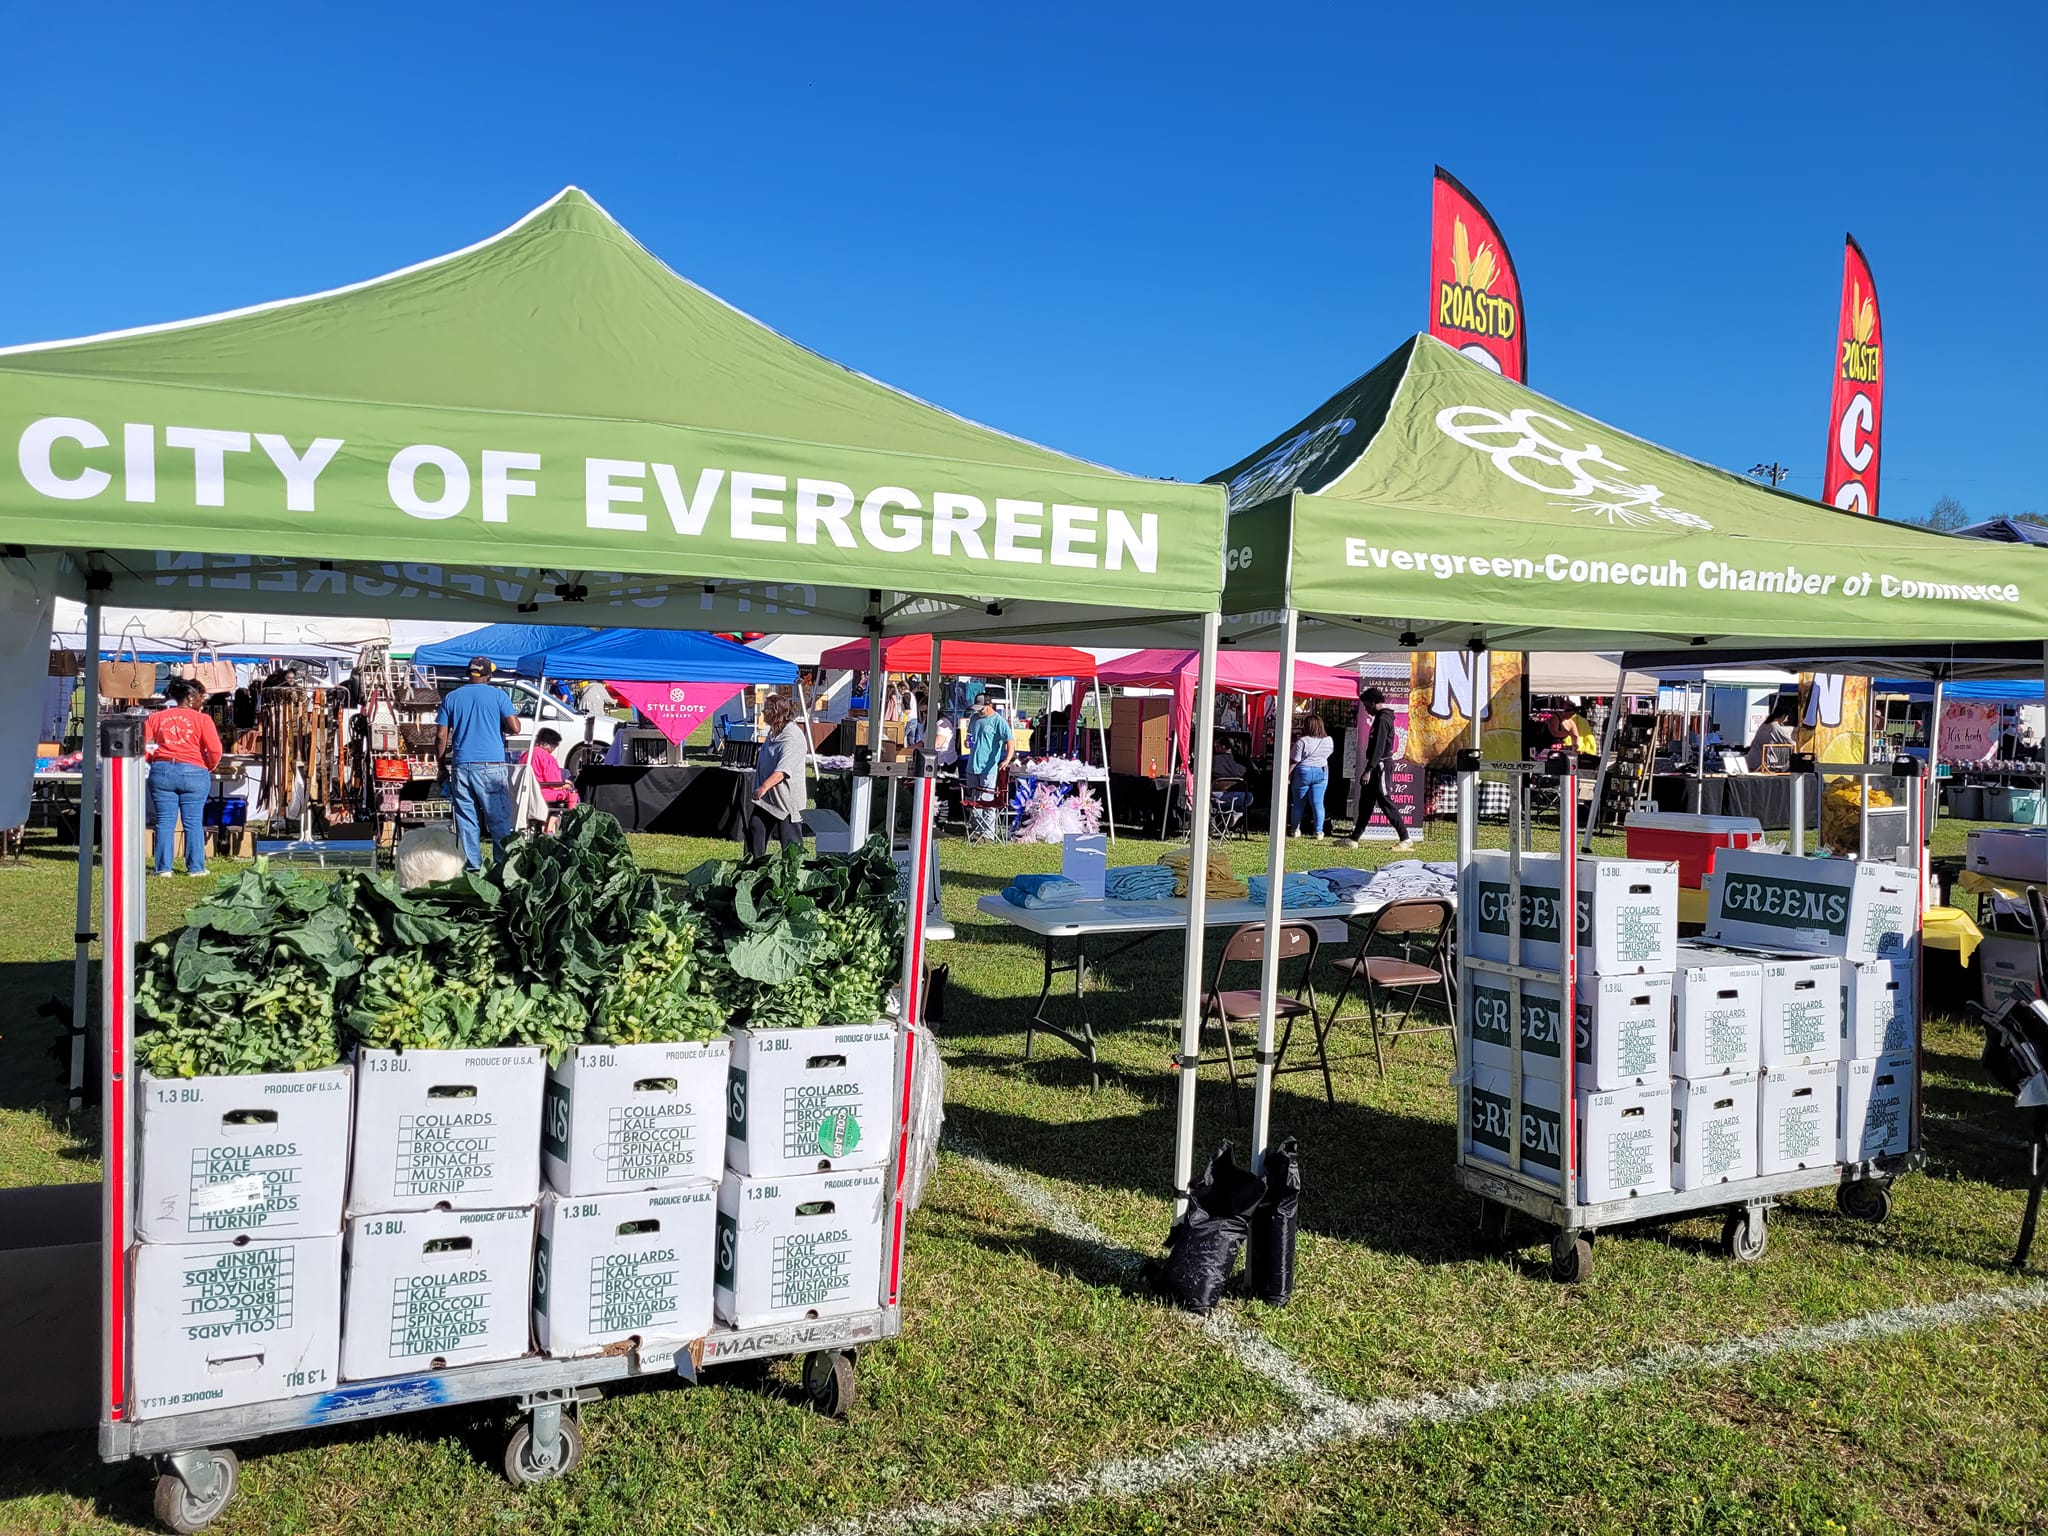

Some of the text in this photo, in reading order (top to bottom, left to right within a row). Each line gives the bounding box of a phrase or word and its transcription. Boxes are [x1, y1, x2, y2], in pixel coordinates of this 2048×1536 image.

[18, 417, 1159, 574] CITY OF EVERGREEN
[1345, 537, 1687, 588] Evergreen-Conecuh
[1698, 561, 1835, 595] Chamber
[1881, 574, 2020, 603] Commerce
[647, 703, 704, 713] STYLE DOTS
[1725, 881, 1846, 923] GREENS
[1624, 907, 1660, 915] COLLARDS
[1624, 934, 1654, 942] SPINACH
[1624, 943, 1660, 951] MUSTARDS
[1624, 951, 1649, 960] TURNIP
[1791, 1001, 1822, 1010] COLLARDS
[1712, 1009, 1745, 1018] COLLARDS
[1712, 1018, 1728, 1026] KALE
[1625, 1028, 1639, 1037] KALE
[1791, 1027, 1818, 1035] SPINACH
[758, 1039, 792, 1051] 1.3 BU.
[835, 1034, 863, 1043] PRODUCE
[1712, 1036, 1741, 1044] SPINACH
[1792, 1035, 1824, 1044] MUSTARDS
[666, 1051, 696, 1060] PRODUCE
[699, 1050, 706, 1058] OF
[1712, 1044, 1747, 1053] MUSTARDS
[1792, 1044, 1814, 1053] TURNIP
[465, 1058, 500, 1066] PRODUCE
[580, 1055, 618, 1068] 1.3 BU.
[1712, 1054, 1736, 1062] TURNIP
[370, 1059, 411, 1072] 1.3 BU.
[265, 1082, 342, 1094] PRODUCE OF U.S.A.
[798, 1083, 859, 1097] COLLARDS
[157, 1089, 203, 1103] 1.3 BU.
[798, 1098, 826, 1108] KALE
[624, 1104, 692, 1118] COLLARDS
[1786, 1105, 1818, 1115] COLLARDS
[416, 1113, 492, 1126] COLLARDS
[624, 1119, 655, 1130] KALE
[1709, 1116, 1739, 1128] COLLARDS
[415, 1128, 450, 1139] KALE
[623, 1128, 689, 1143] BROCCOLI
[1616, 1130, 1651, 1140] COLLARDS
[1786, 1130, 1813, 1140] SPINACH
[414, 1139, 488, 1153] BROCCOLI
[622, 1141, 681, 1154] SPINACH
[1616, 1140, 1632, 1149] KALE
[1786, 1138, 1819, 1148] MUSTARDS
[210, 1143, 296, 1160] COLLARDS
[1709, 1152, 1740, 1163] MUSTARDS
[1786, 1150, 1808, 1159] TURNIP
[413, 1153, 478, 1167] SPINACH
[622, 1152, 693, 1167] MUSTARDS
[1616, 1157, 1646, 1168] SPINACH
[210, 1160, 250, 1173] KALE
[411, 1165, 492, 1180] MUSTARDS
[621, 1166, 669, 1179] TURNIP
[1616, 1166, 1653, 1176] MUSTARDS
[1709, 1162, 1730, 1173] TURNIP
[410, 1181, 464, 1194] TURNIP
[825, 1181, 852, 1189] PRODUCE
[863, 1177, 879, 1185] U.S.A.
[1616, 1176, 1642, 1186] TURNIP
[747, 1186, 781, 1200] 1.3 BU.
[650, 1194, 711, 1206] PRODUCE OF U.S.A.
[563, 1204, 600, 1219] 1.3 BU.
[206, 1214, 267, 1229] TURNIP
[460, 1213, 506, 1224] PRODUCE OF
[364, 1221, 406, 1235] 1.3 BU.
[787, 1230, 847, 1246] COLLARDS
[606, 1249, 674, 1266] COLLARDS
[787, 1245, 815, 1257] KALE
[216, 1249, 277, 1267] TURNIP
[786, 1254, 845, 1270] BROCCOLI
[185, 1263, 276, 1285] MUSTARDS
[606, 1266, 638, 1278] KALE
[785, 1265, 838, 1281] SPINACH
[411, 1270, 487, 1288] COLLARDS
[605, 1275, 671, 1291] BROCCOLI
[785, 1276, 848, 1293] MUSTARDS
[202, 1277, 275, 1297] SPINACH
[411, 1287, 446, 1300] KALE
[191, 1292, 275, 1312] BROCCOLI
[605, 1288, 663, 1304] SPINACH
[784, 1290, 828, 1305] TURNIP
[410, 1296, 483, 1314] BROCCOLI
[604, 1299, 675, 1317] MUSTARDS
[235, 1305, 274, 1321] KALE
[408, 1310, 473, 1328] SPINACH
[604, 1315, 652, 1330] TURNIP
[189, 1319, 275, 1340] COLLARDS
[407, 1321, 486, 1341] MUSTARDS
[406, 1338, 460, 1353] TURNIP
[168, 1389, 223, 1404] PRODUCE OF
